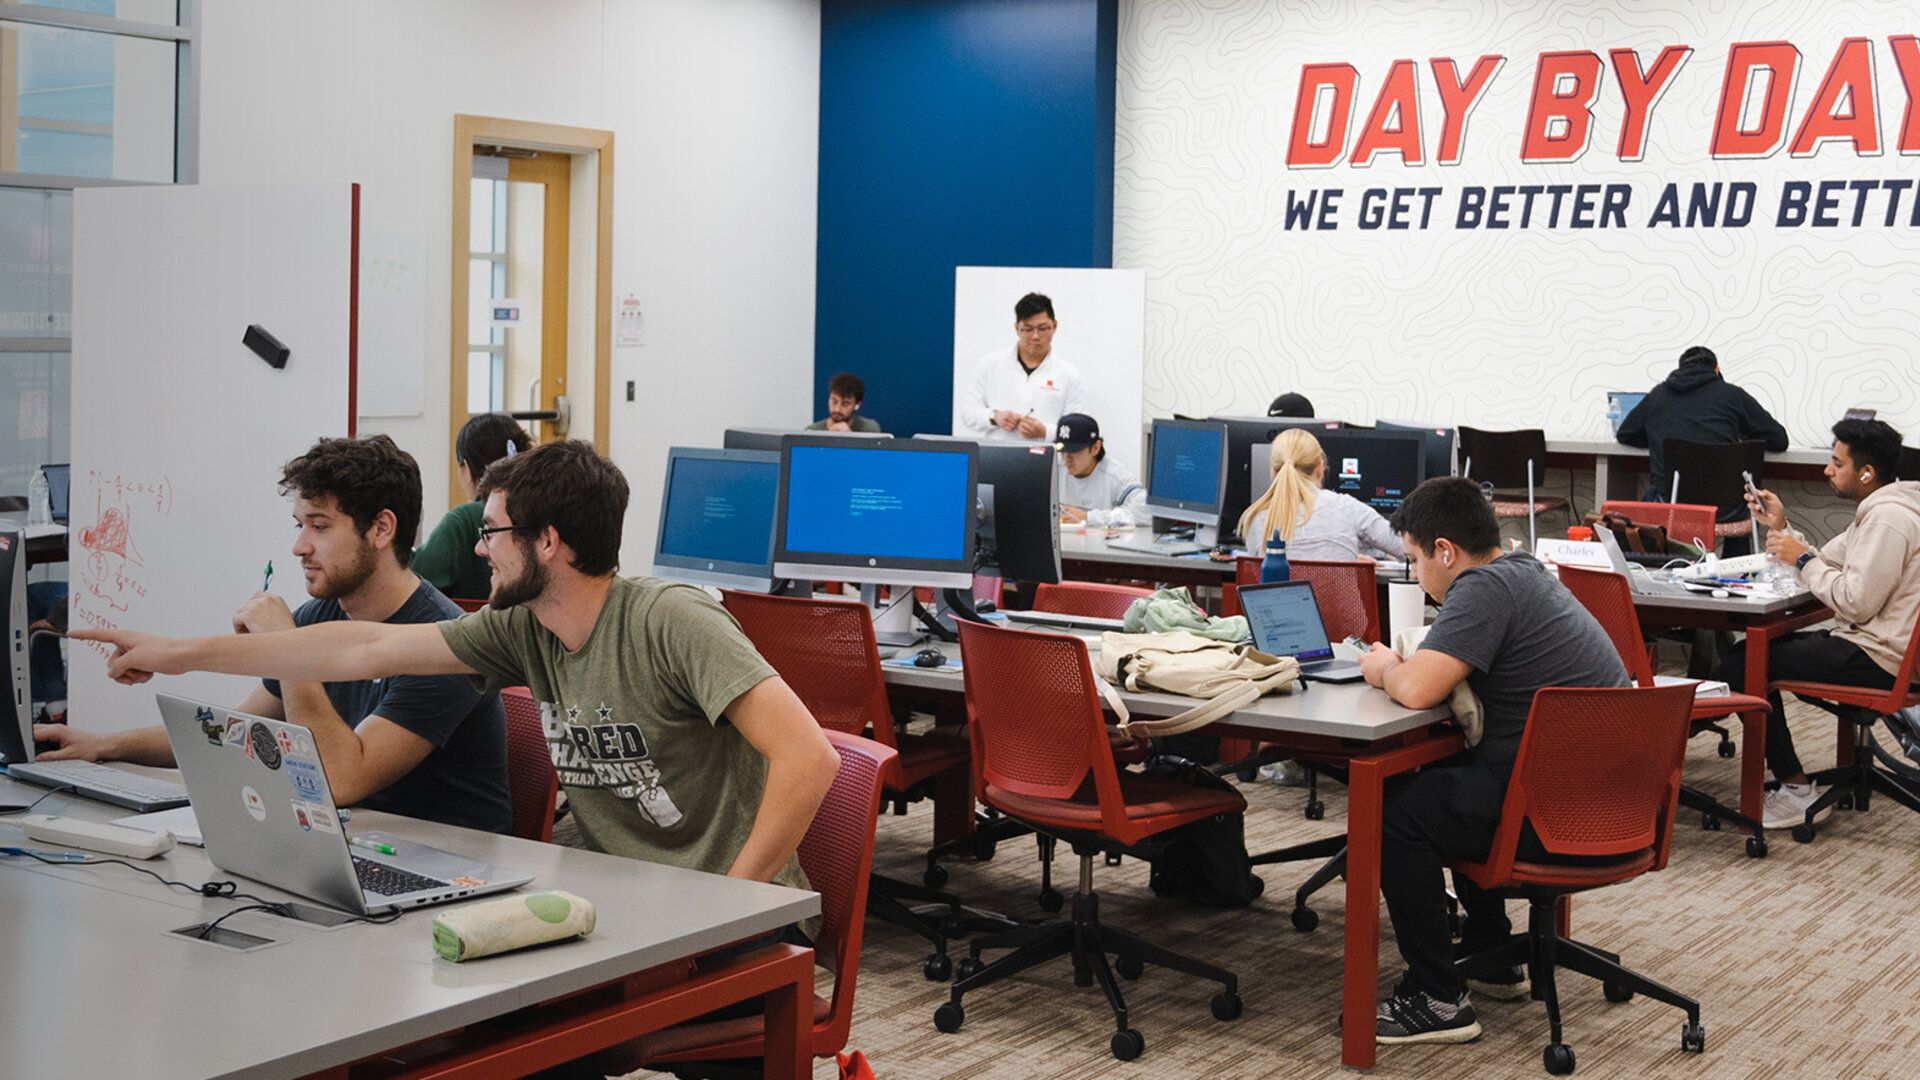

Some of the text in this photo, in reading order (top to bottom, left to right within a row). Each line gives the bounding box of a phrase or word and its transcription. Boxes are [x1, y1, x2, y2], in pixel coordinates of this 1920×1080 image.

[1285, 55, 1507, 168] DAY
[1520, 45, 1694, 164] BY
[1284, 180, 1920, 231] WE GET BETTER AND BETT
[1558, 545, 1594, 557] Charles
[564, 773, 596, 785] THAN
